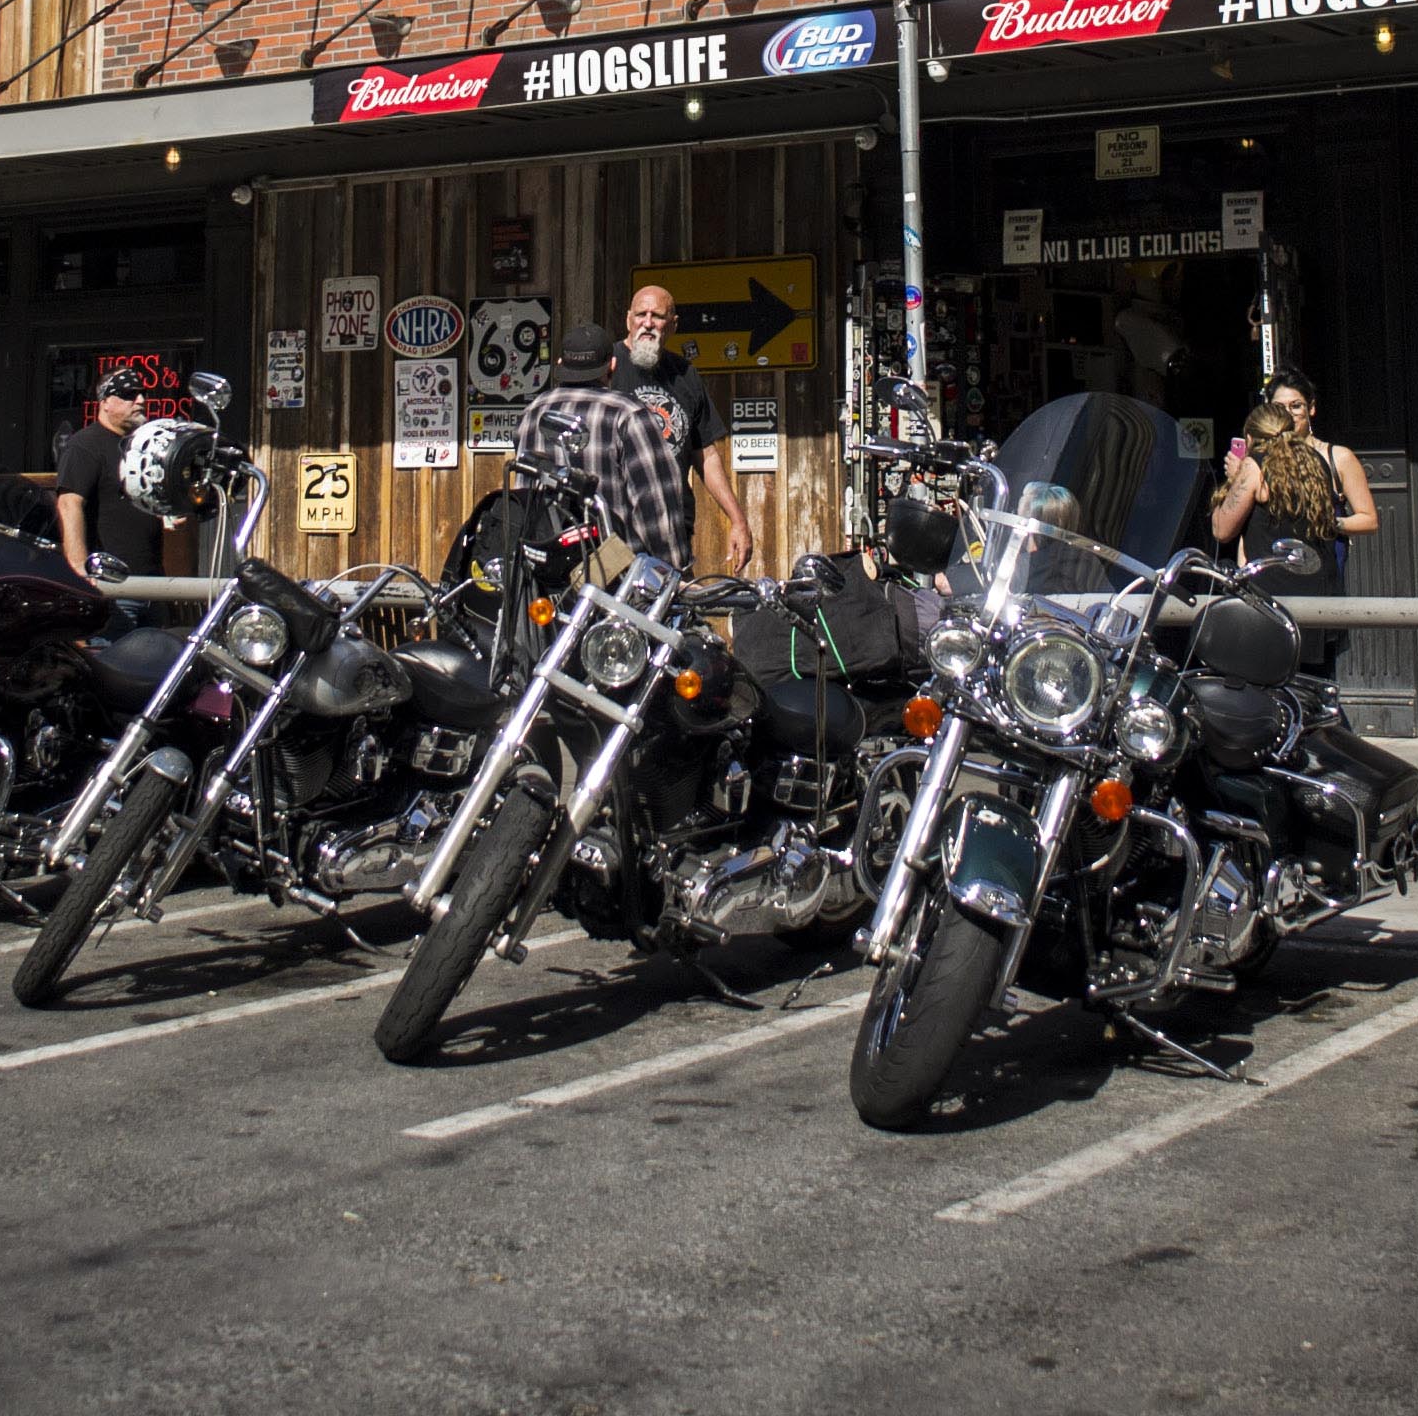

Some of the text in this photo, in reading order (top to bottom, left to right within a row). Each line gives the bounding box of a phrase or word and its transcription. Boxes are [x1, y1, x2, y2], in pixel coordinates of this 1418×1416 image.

[347, 23, 874, 113] Budweiser #HOGSLIFE BUD LIGHT
[1116, 131, 1140, 142] NO
[1043, 230, 1223, 264] NO CLUB COLORS
[326, 290, 376, 314] PHOTO
[396, 297, 452, 313] CHAMPIONSHIP
[328, 314, 371, 337] ZONE
[396, 306, 452, 346] NHRA
[477, 319, 542, 378] 69
[162, 366, 180, 388] &
[83, 397, 195, 428] HERS
[492, 412, 519, 428] WHE
[732, 401, 778, 418] BEER
[733, 437, 777, 449] NO BEER
[304, 462, 350, 500] 25
